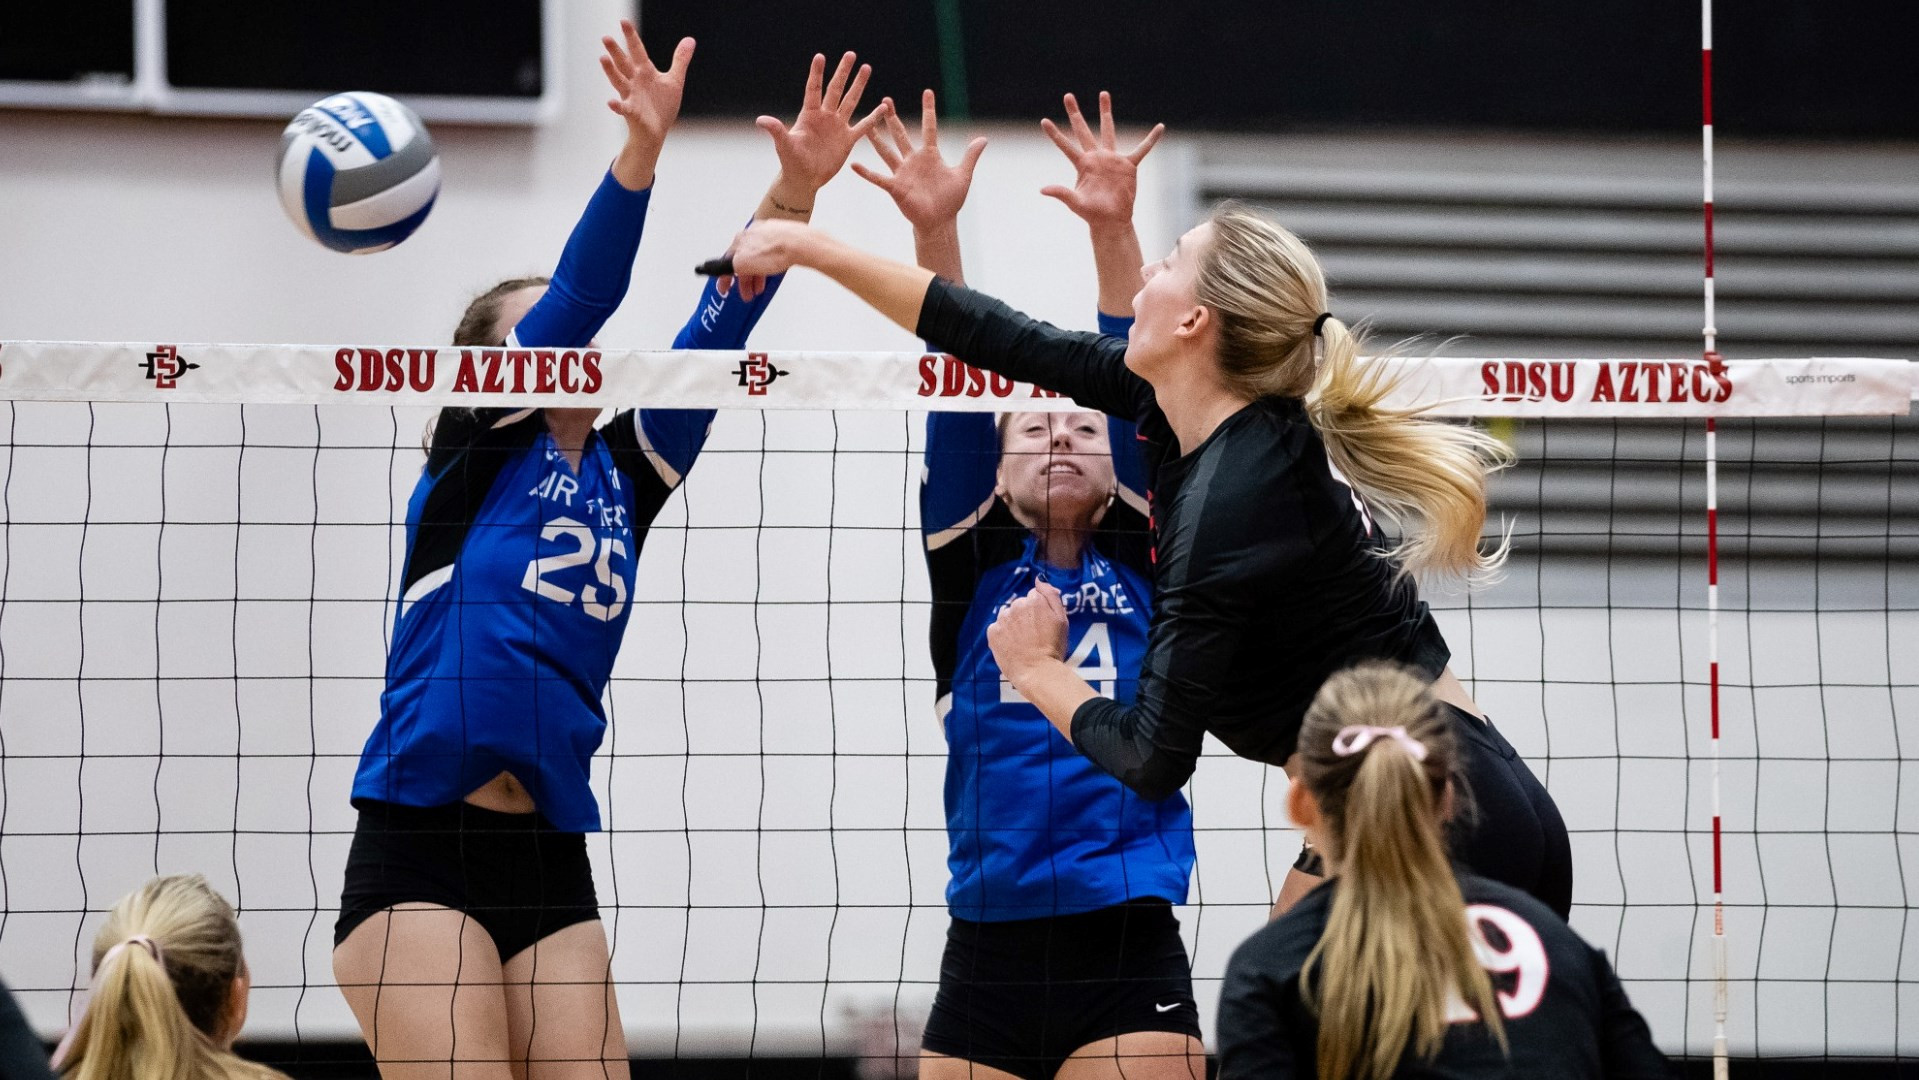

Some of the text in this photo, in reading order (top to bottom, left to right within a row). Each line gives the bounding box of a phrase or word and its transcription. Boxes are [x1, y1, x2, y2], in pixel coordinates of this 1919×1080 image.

[334, 348, 603, 394] SDSU AZTECS
[1481, 361, 1733, 403] SDSU AZTECS
[1786, 374, 1856, 384] sports imports
[528, 471, 579, 507] AIR
[521, 516, 627, 622] 25
[1062, 582, 1134, 614] ORCE
